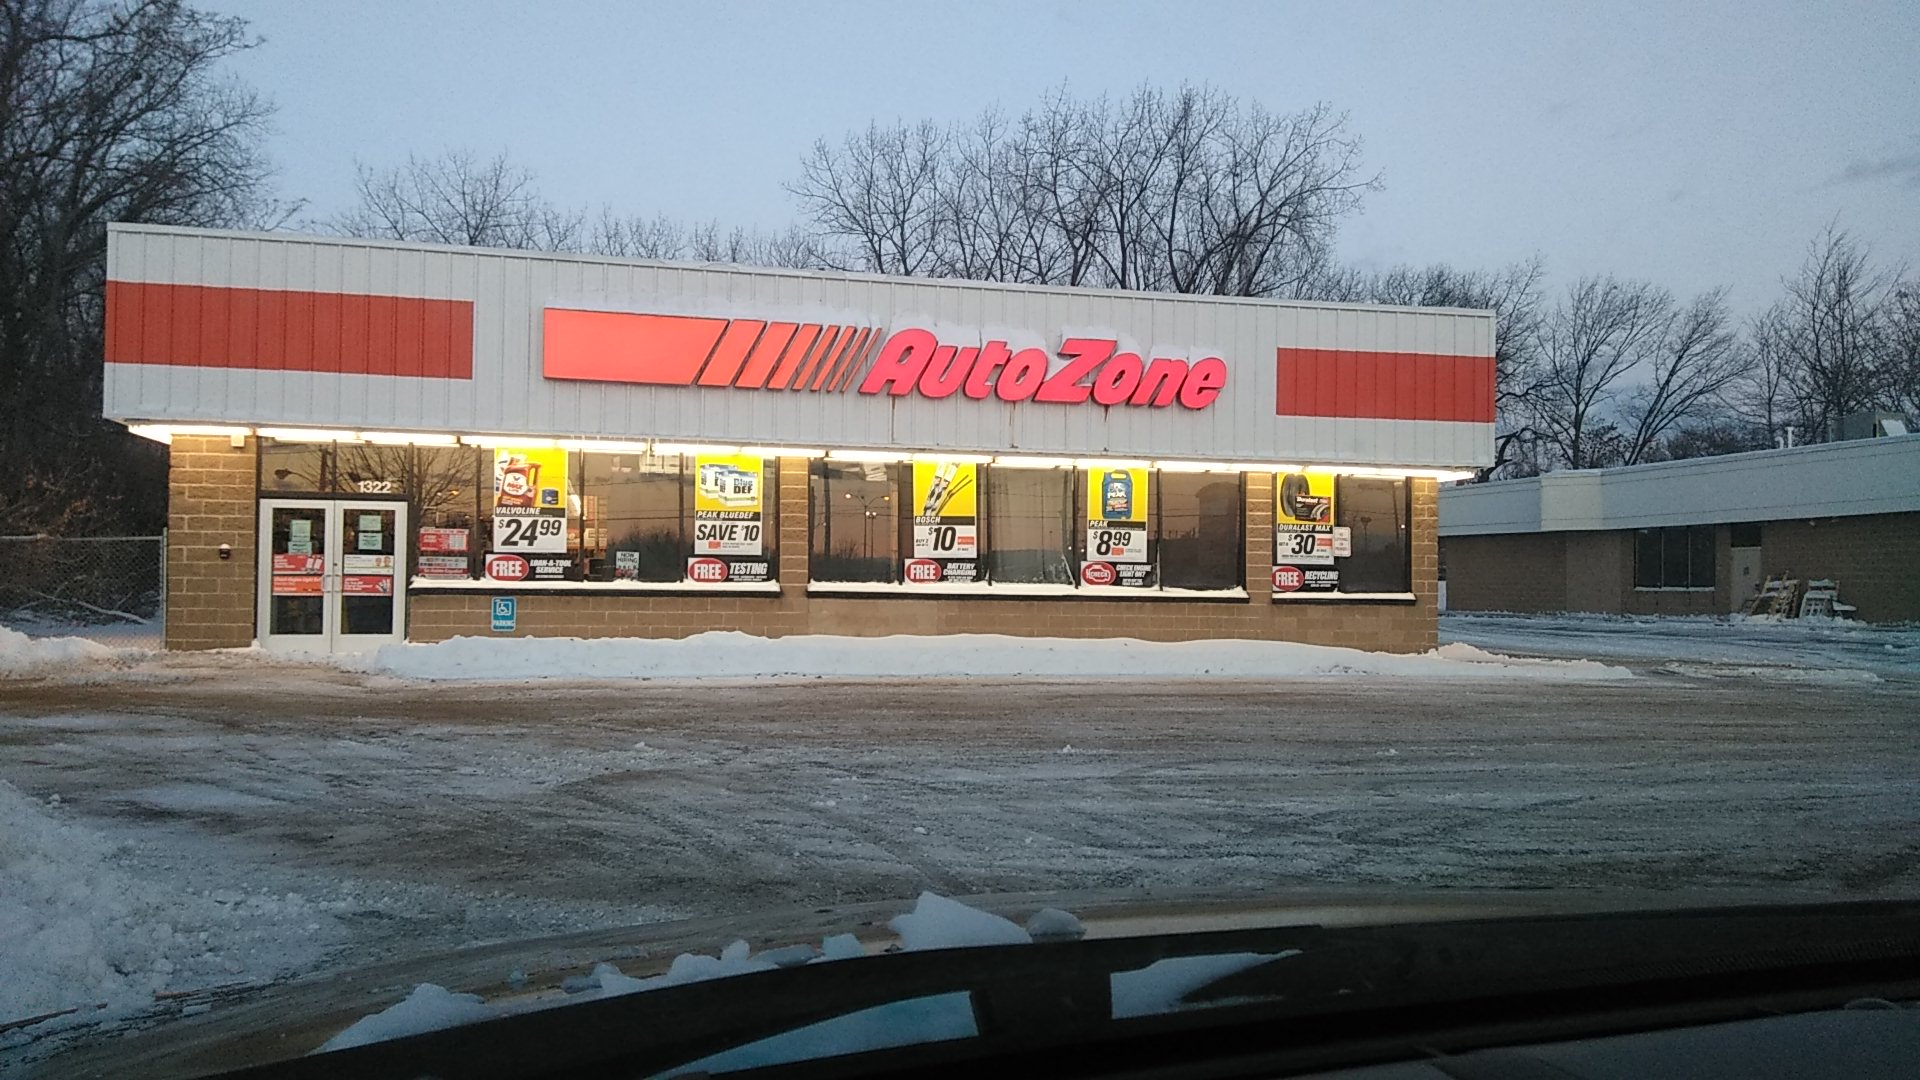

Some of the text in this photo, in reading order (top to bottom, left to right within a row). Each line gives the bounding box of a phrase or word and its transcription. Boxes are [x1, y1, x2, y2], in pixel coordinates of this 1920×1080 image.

[858, 326, 1228, 410] AutoZone
[357, 480, 392, 494] 1322
[496, 507, 541, 515] VALVOLINE
[697, 511, 718, 519] PEAK
[915, 516, 941, 524] BOSCH
[1315, 524, 1331, 532] MAX
[696, 524, 760, 541] SAVE $10
[928, 526, 957, 552] $10
[1288, 533, 1316, 555] $30
[492, 560, 522, 577] FREE
[535, 566, 564, 574] SERVICE
[693, 563, 722, 579] FREE
[729, 562, 769, 575] TESTING
[909, 564, 936, 580] FREE
[1275, 571, 1300, 586] FREE
[1304, 570, 1339, 581] RECYCLING
